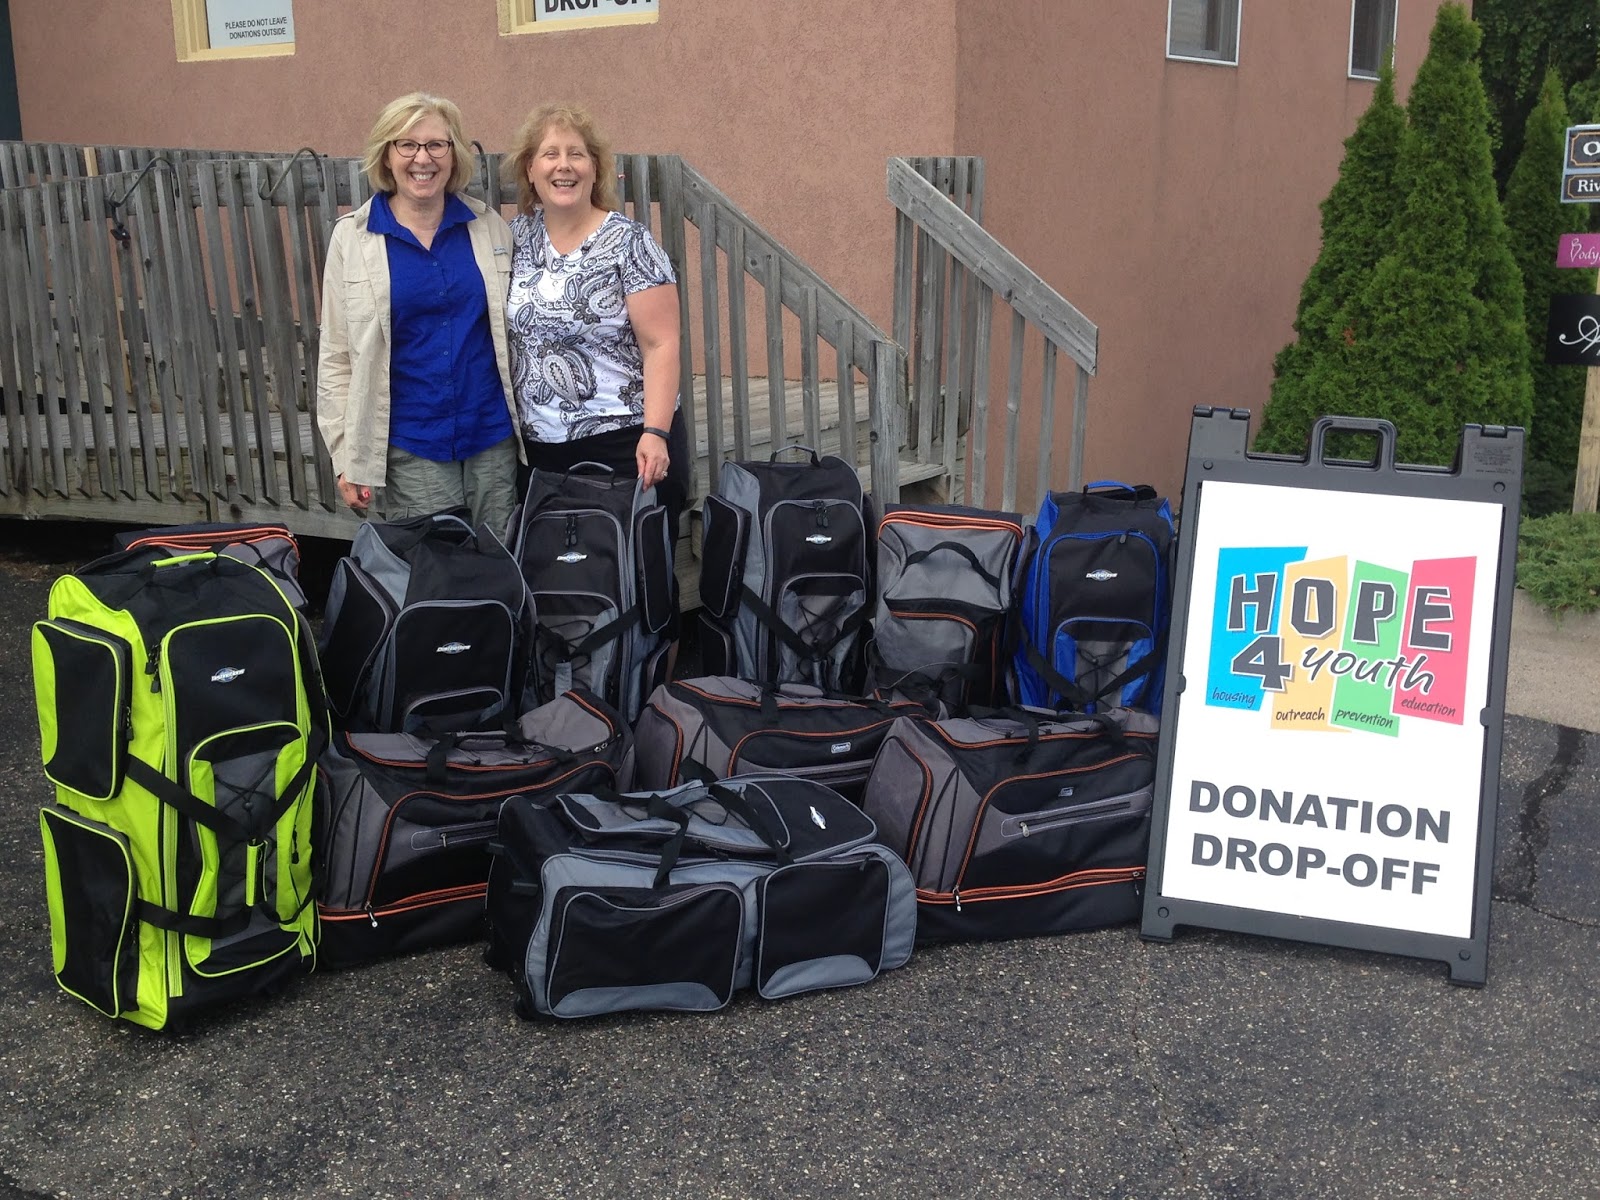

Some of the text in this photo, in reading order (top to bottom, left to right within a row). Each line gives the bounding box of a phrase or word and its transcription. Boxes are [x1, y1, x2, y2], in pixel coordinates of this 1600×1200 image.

[225, 21, 246, 29] PLEASE
[256, 18, 268, 26] NOT
[269, 17, 287, 25] LEAVE
[229, 28, 286, 39] DONATIONS OUTSIDE
[1227, 572, 1453, 651] HOPE
[1231, 635, 1292, 691] 4
[1212, 687, 1256, 705] housing
[1276, 707, 1325, 721] outreach
[1401, 697, 1456, 717] education
[1334, 709, 1393, 729] prevention
[1189, 780, 1450, 844] DONATION
[1191, 833, 1440, 895] DROP-OFF
